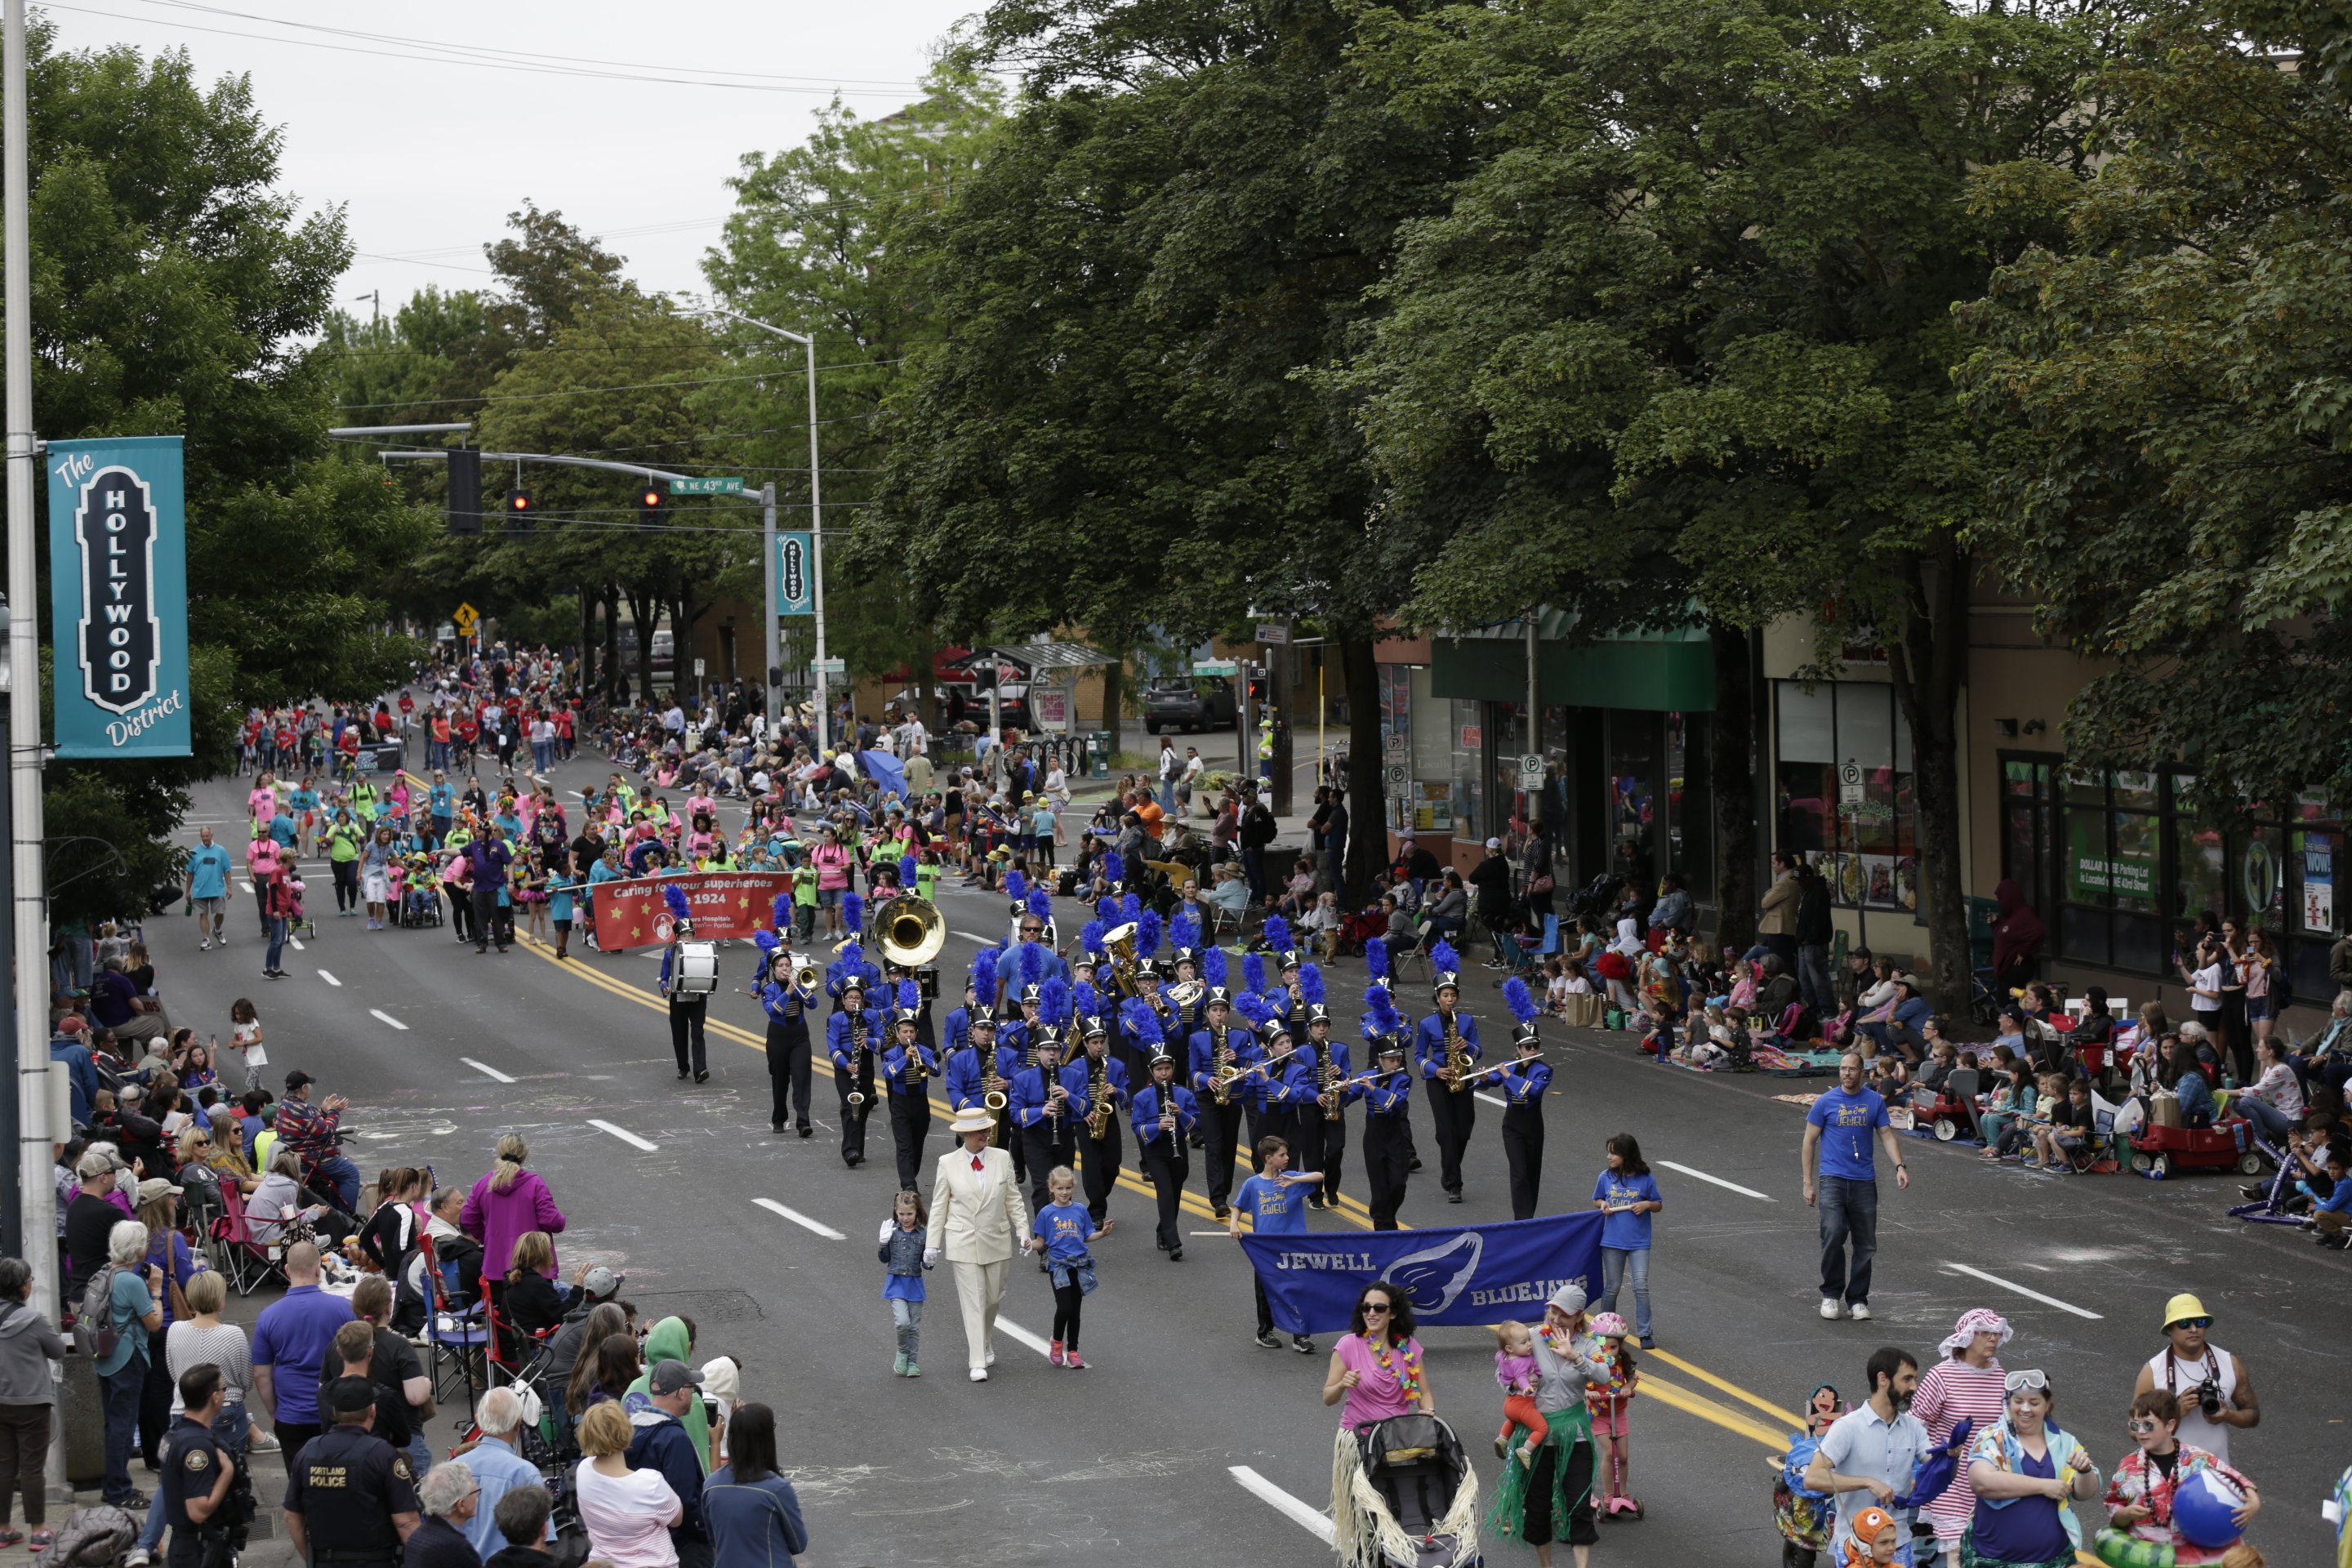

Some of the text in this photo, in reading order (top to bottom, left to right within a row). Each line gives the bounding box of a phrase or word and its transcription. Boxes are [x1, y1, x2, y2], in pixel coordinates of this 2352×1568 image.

[55, 454, 94, 488] The
[690, 481, 740, 491] NE 43RD AVE
[776, 535, 787, 545] The
[105, 490, 133, 693] HOLLYWOOD
[790, 596, 810, 612] District
[105, 689, 183, 746] District
[1392, 738, 1399, 748] P
[1417, 759, 1452, 771] Locally
[1529, 760, 1536, 769] P
[1395, 770, 1401, 779] P
[1847, 770, 1856, 780] P
[2305, 843, 2331, 853] THE WEEKLY
[2080, 858, 2149, 878] DOLLAR TEE Parking Lot
[2306, 852, 2331, 872] WOW!
[2080, 872, 2085, 882] is
[2086, 873, 2105, 885] Located
[2113, 877, 2121, 887] NE
[2121, 878, 2133, 889] 43rd
[2134, 879, 2149, 891] Street
[614, 886, 652, 898] Caring
[655, 882, 666, 893] fo
[704, 878, 773, 890] superheroes
[694, 893, 726, 905] 1924
[1853, 1106, 1867, 1114] Jays
[1838, 1116, 1867, 1126] JEWELL
[1259, 1192, 1285, 1204] Blue Jays
[1623, 1189, 1638, 1198] Jays
[1259, 1203, 1287, 1215] JEWELL
[1276, 1252, 1377, 1271] JEWELL
[1471, 1274, 1588, 1306] BLUEJAYS
[310, 1466, 346, 1476] PORTLAND
[309, 1476, 347, 1488] POLICE
